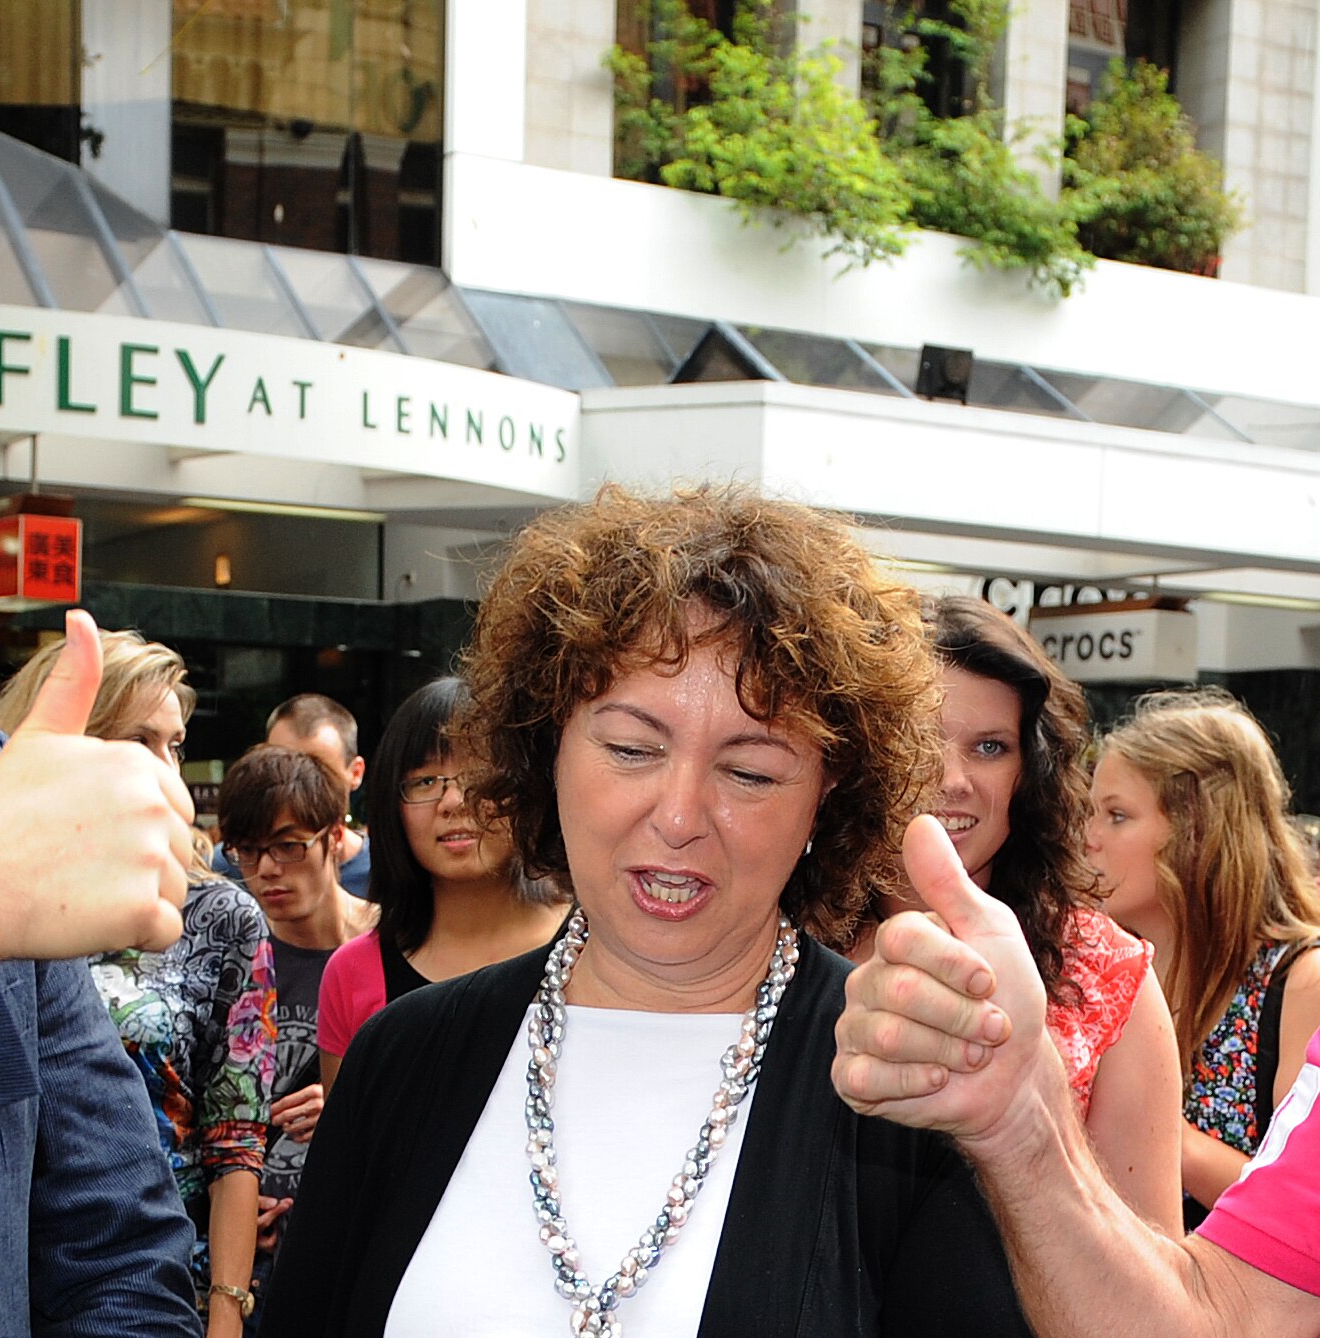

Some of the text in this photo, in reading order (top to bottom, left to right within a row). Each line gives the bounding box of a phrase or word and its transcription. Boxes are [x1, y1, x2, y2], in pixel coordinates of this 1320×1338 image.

[247, 375, 314, 421] AT
[362, 390, 569, 465] LENNONS
[1043, 630, 1134, 661] crocs
